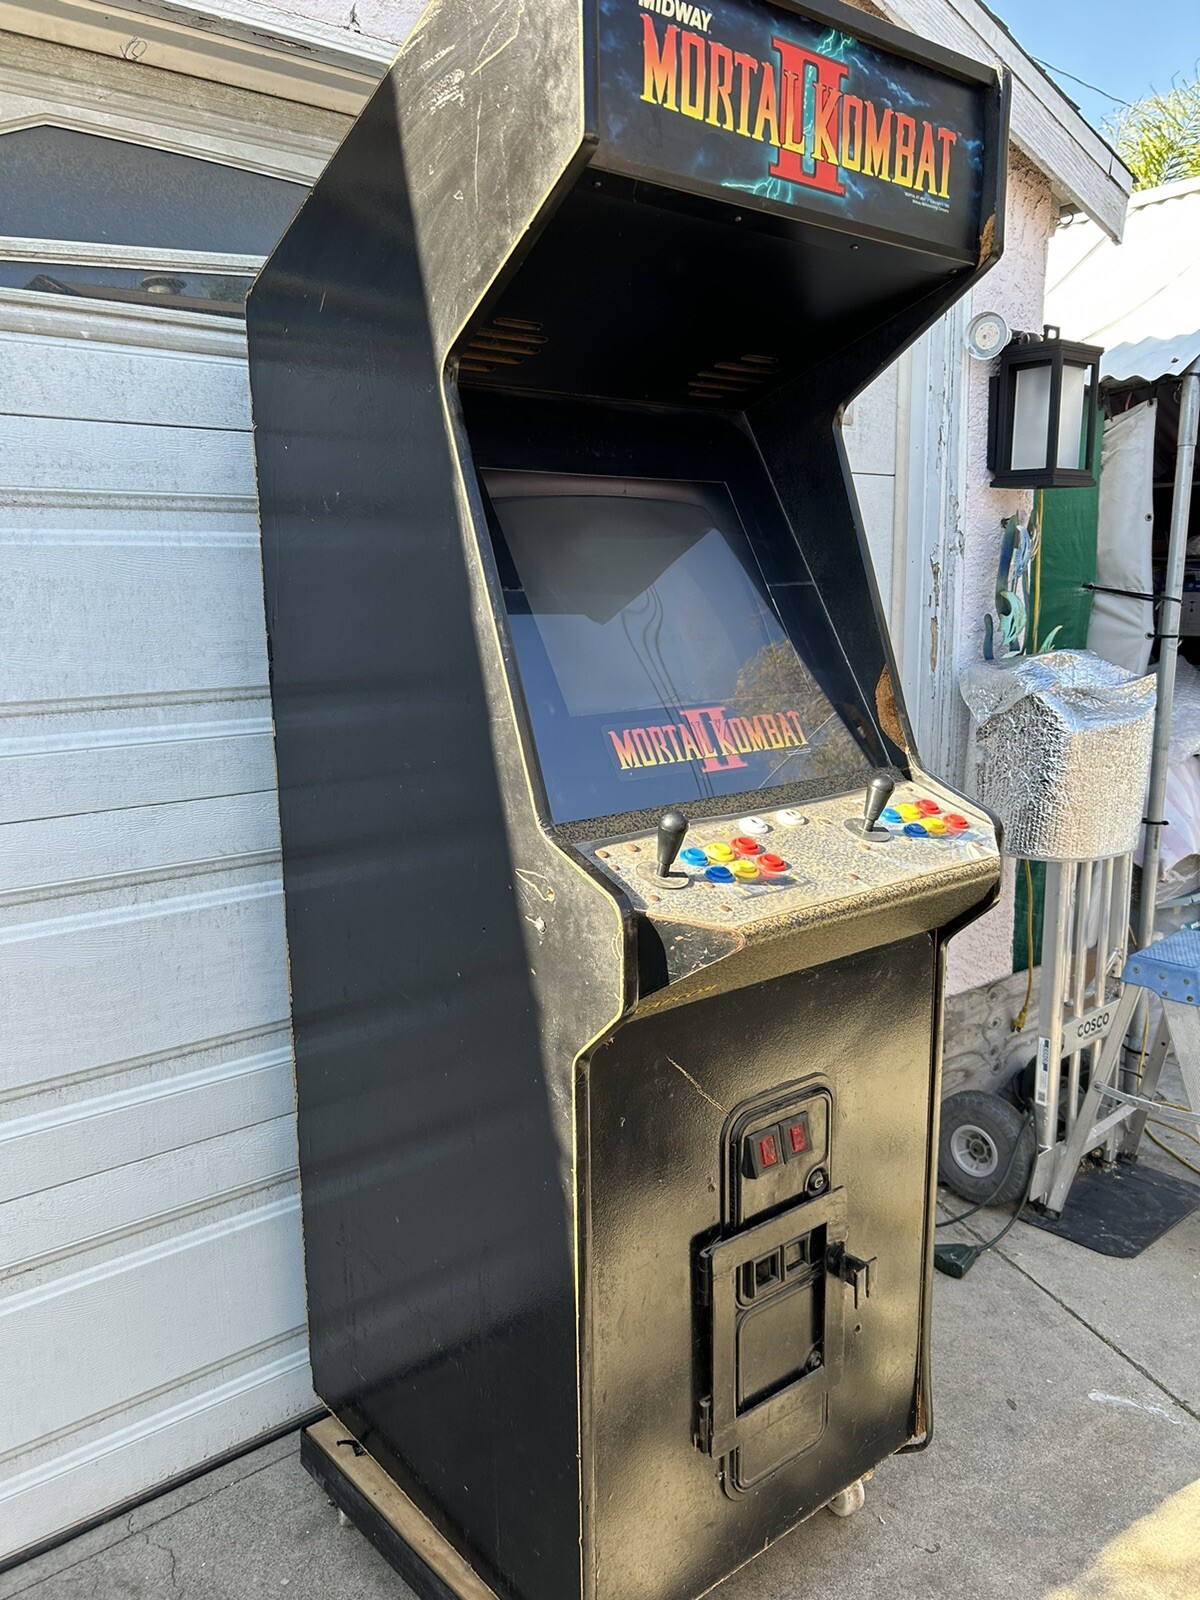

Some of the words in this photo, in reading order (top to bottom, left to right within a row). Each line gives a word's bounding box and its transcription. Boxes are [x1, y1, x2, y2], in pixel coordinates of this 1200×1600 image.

[639, 13, 805, 155] MORTAL
[811, 80, 956, 199] KOMBAT
[608, 721, 718, 770] MORTAL
[709, 710, 809, 756] KOMBAT
[1077, 1012, 1110, 1038] COSCO
